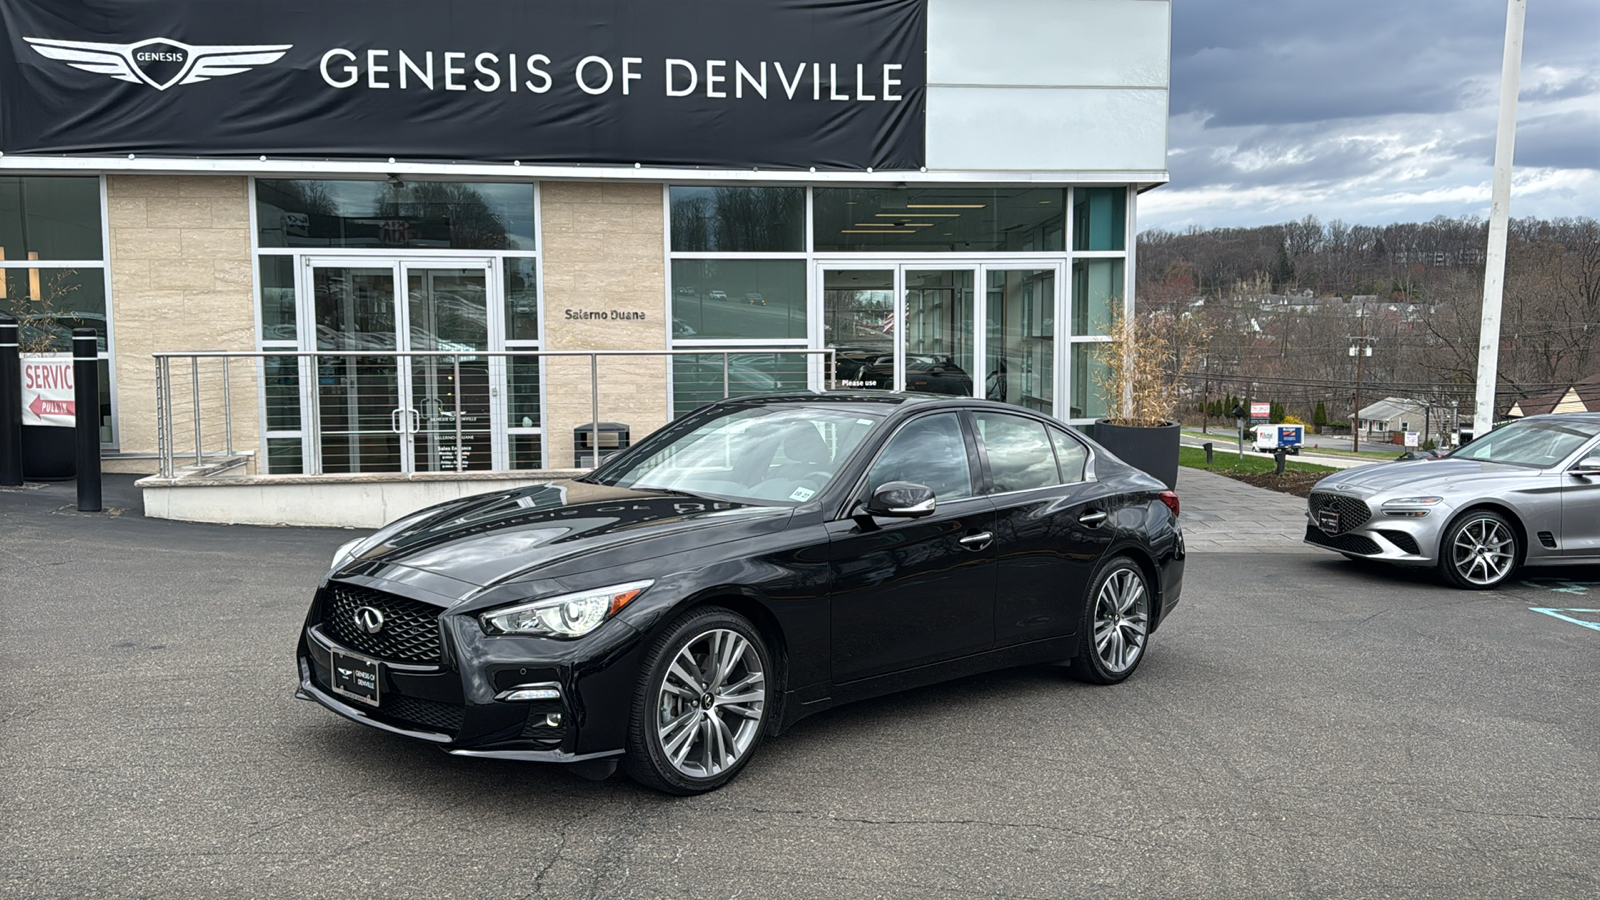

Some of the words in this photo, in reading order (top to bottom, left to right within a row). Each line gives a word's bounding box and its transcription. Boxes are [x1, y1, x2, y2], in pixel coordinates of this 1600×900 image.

[136, 52, 184, 62] GENESIS
[319, 47, 552, 94] GENESIS
[575, 55, 643, 95] OF
[665, 58, 903, 101] DENVILLE
[565, 308, 608, 320] Salerno
[610, 310, 646, 320] Duane
[25, 364, 75, 390] SERVIC
[41, 401, 59, 413] PULL
